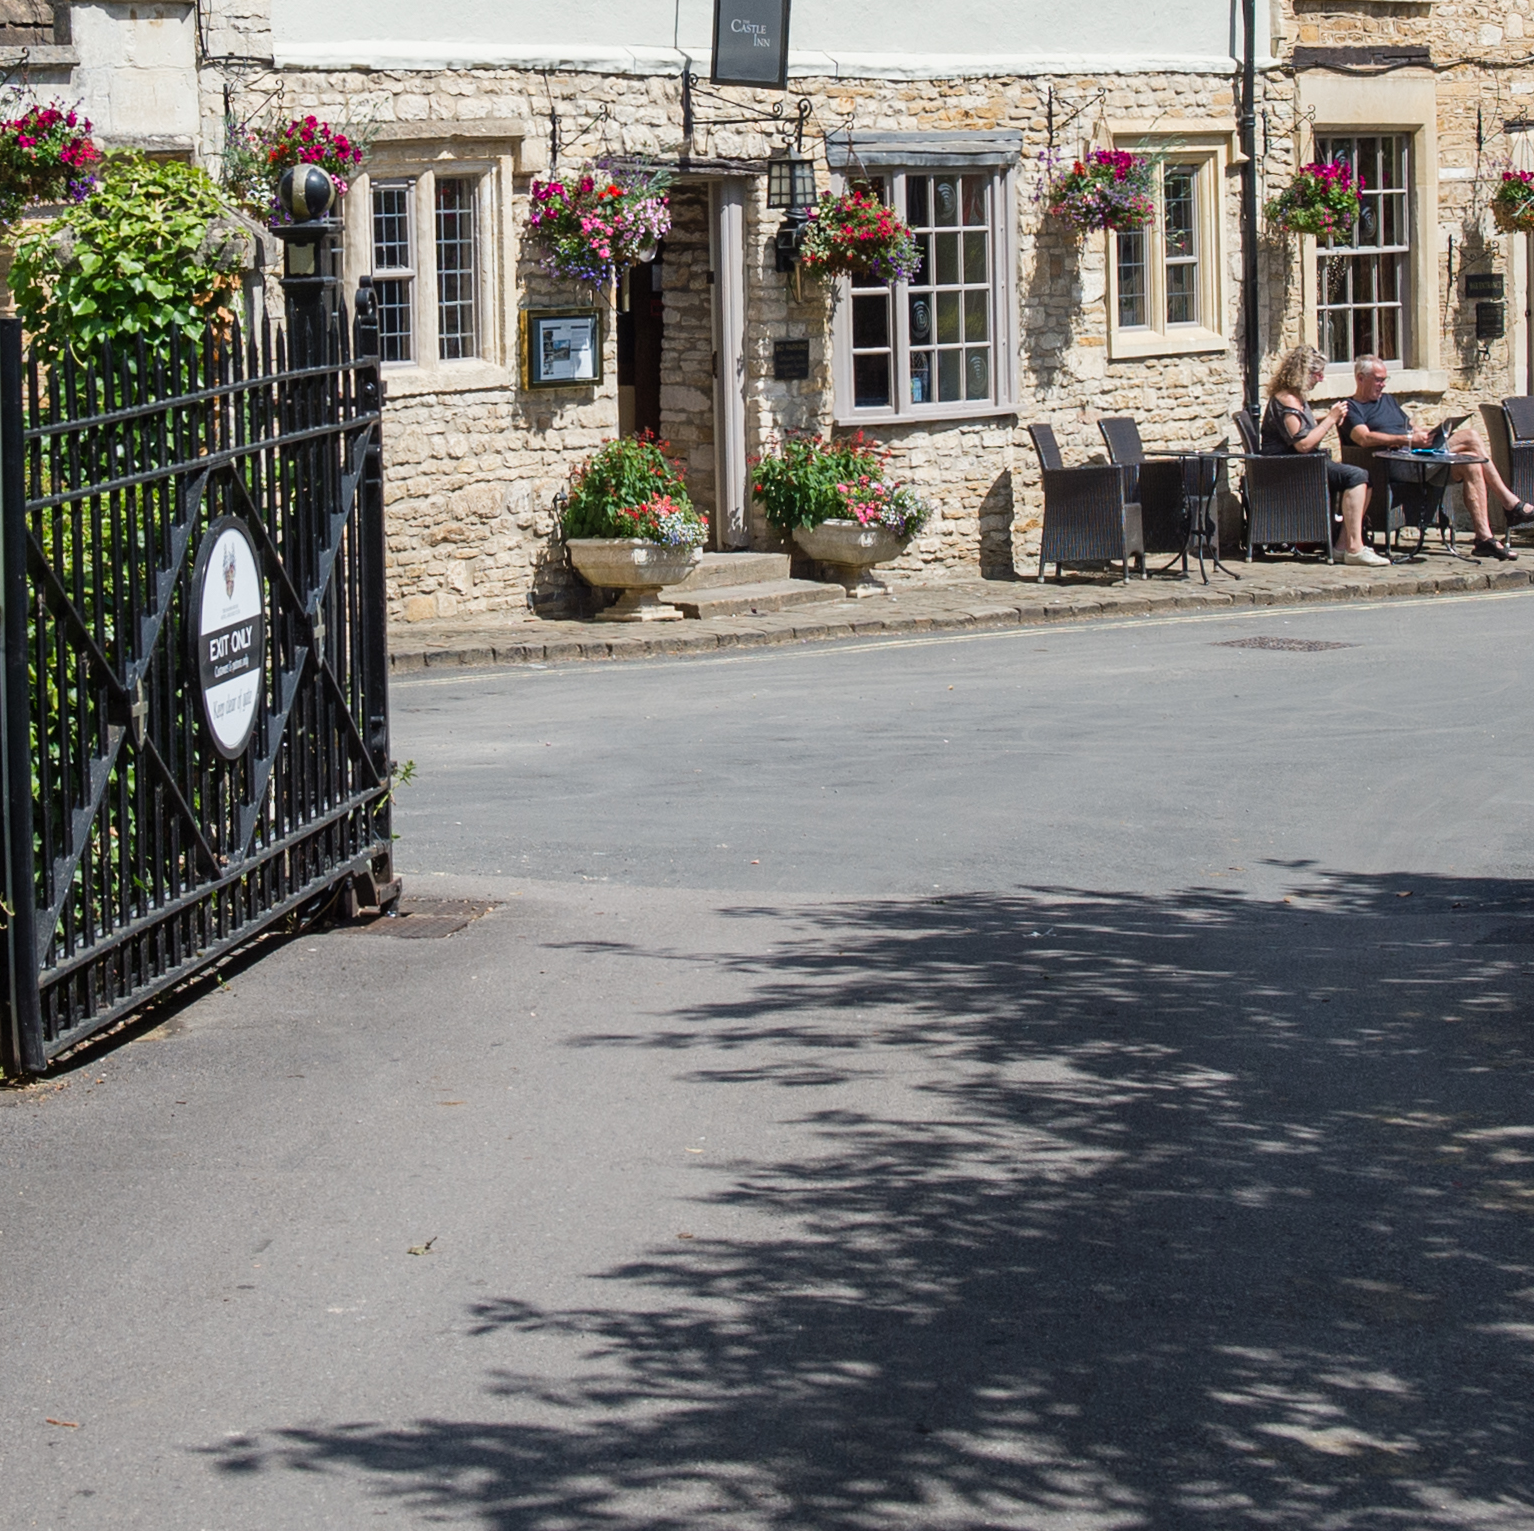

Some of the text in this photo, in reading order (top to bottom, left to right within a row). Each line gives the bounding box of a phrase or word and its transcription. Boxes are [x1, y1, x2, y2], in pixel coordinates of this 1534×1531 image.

[731, 18, 767, 34] CASTLE
[754, 33, 770, 47] INN
[210, 625, 253, 661] EXIT ONLY
[213, 700, 225, 720] Keep
